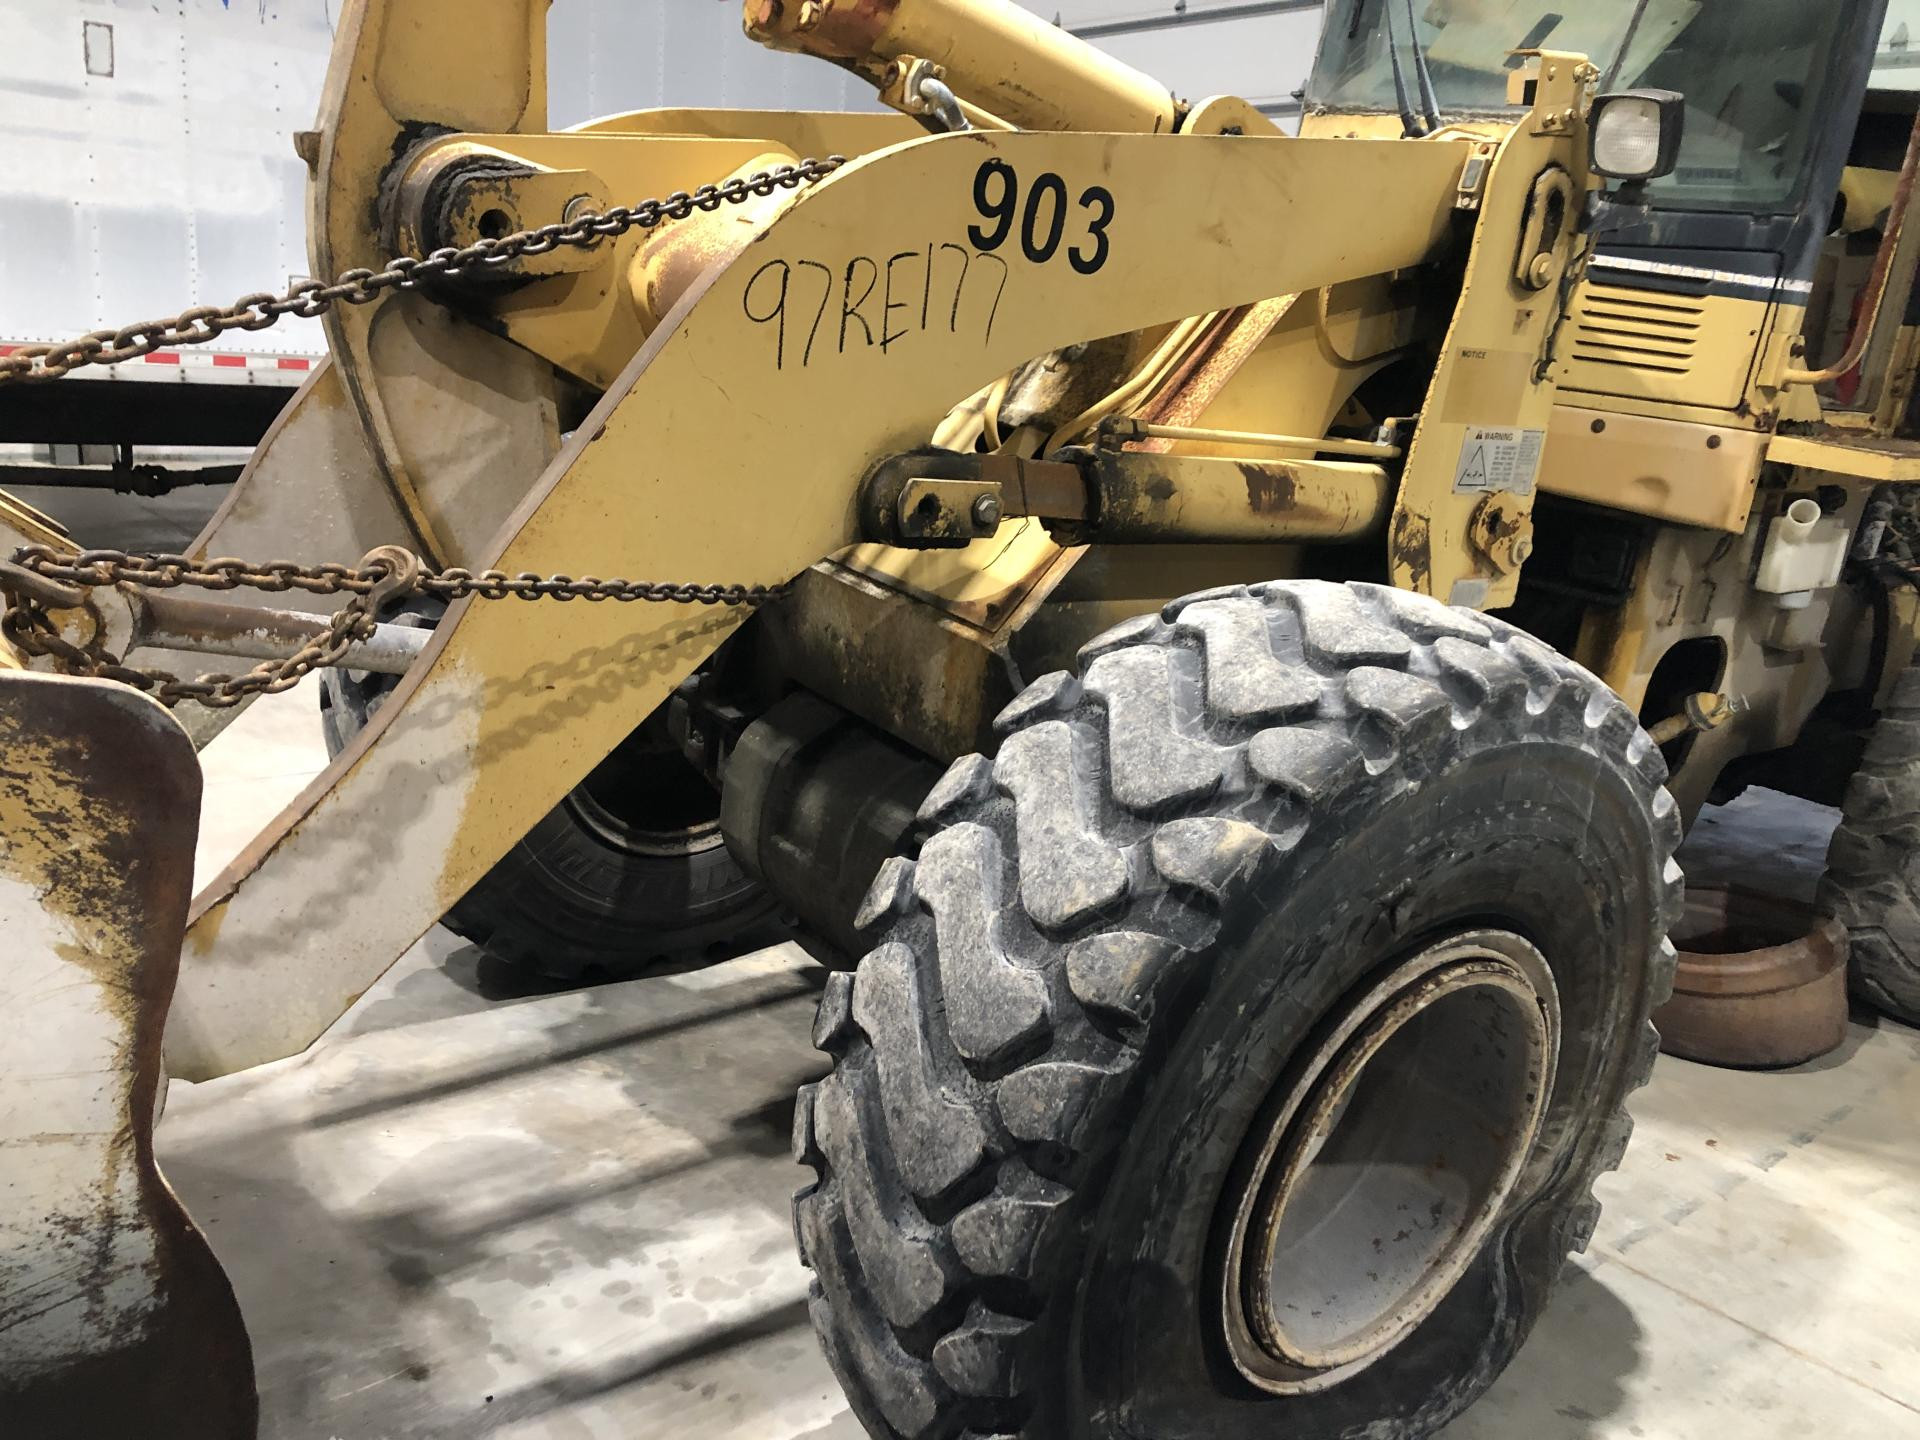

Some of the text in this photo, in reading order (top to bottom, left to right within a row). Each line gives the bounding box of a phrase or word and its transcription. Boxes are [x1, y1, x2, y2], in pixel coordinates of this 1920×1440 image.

[968, 157, 1115, 275] 903
[1461, 350, 1487, 359] NOTICE
[1484, 432, 1513, 441] WARNING
